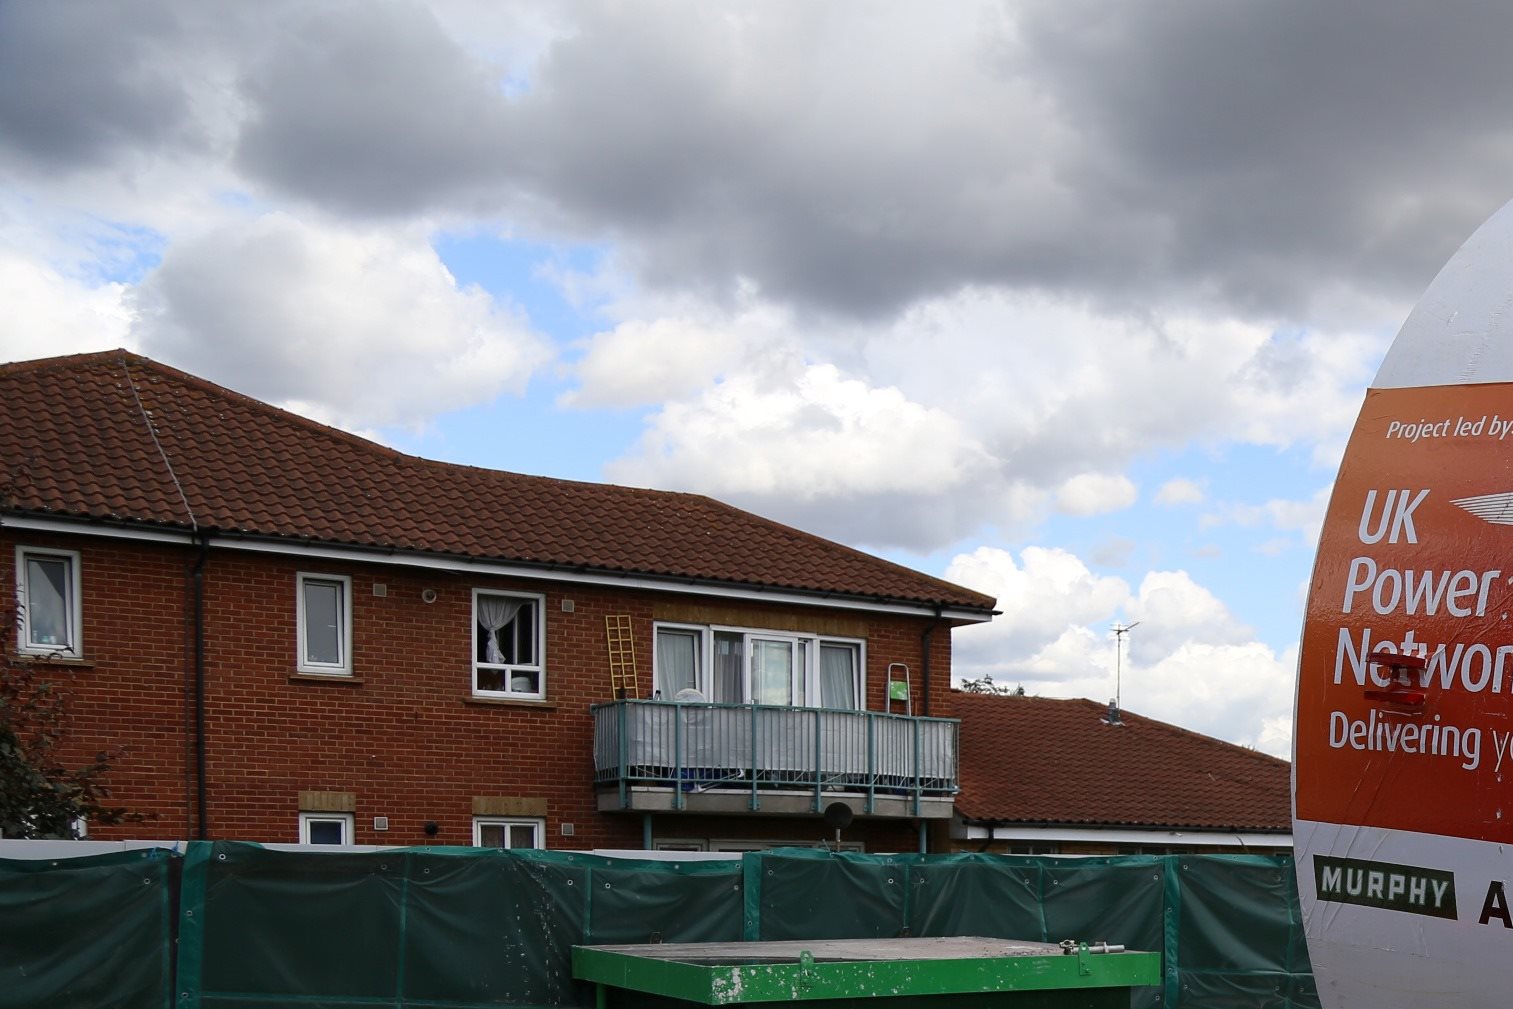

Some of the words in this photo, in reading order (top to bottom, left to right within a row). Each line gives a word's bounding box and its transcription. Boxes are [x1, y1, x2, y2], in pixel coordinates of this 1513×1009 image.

[1386, 418, 1451, 443] Project
[1453, 415, 1488, 437] led
[1358, 488, 1431, 545] UK
[1342, 556, 1501, 617] Power
[1329, 709, 1482, 770] Delivering
[1321, 865, 1449, 909] MURPHY
